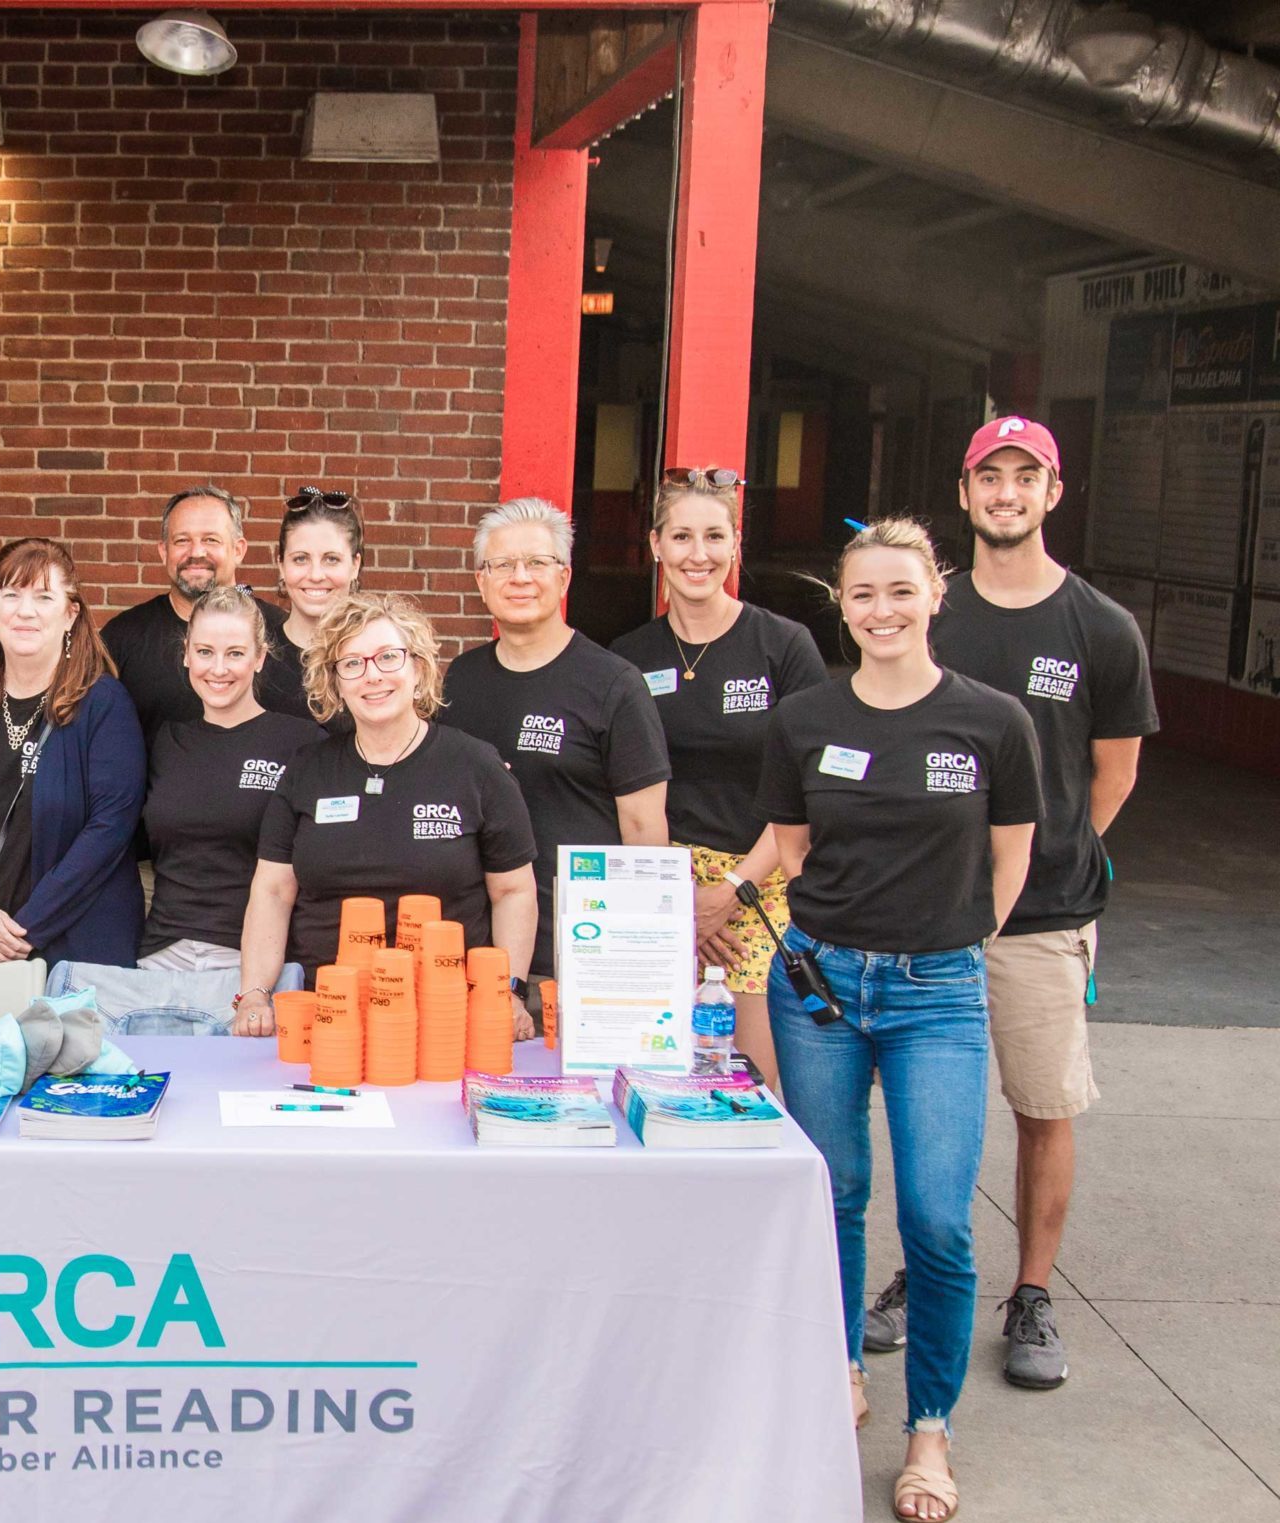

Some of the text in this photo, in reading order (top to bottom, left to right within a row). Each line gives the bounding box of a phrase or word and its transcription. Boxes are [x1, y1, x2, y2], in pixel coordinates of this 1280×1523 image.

[1144, 264, 1187, 302] PHILS
[1174, 369, 1242, 391] PHILADELPHIA
[1031, 656, 1078, 679] GRCA
[723, 676, 770, 693] GRCA
[1027, 681, 1073, 697] READING
[1029, 674, 1075, 690] GREATER
[722, 700, 769, 710] READING
[723, 692, 768, 704] GREATER
[522, 714, 565, 733] GRCA
[518, 738, 561, 750] READING
[519, 731, 562, 743] GREATER
[926, 752, 977, 772] GRCA
[239, 778, 278, 789] READIN
[241, 772, 281, 782] GREATE
[926, 771, 976, 783] GREATER
[926, 778, 977, 790] READING
[412, 803, 462, 821] GRCA
[412, 821, 461, 831] GREATER
[412, 828, 463, 836] READING
[640, 1035, 677, 1051] FBA
[73, 1388, 417, 1435] READING
[71, 1443, 224, 1471] Alliance
